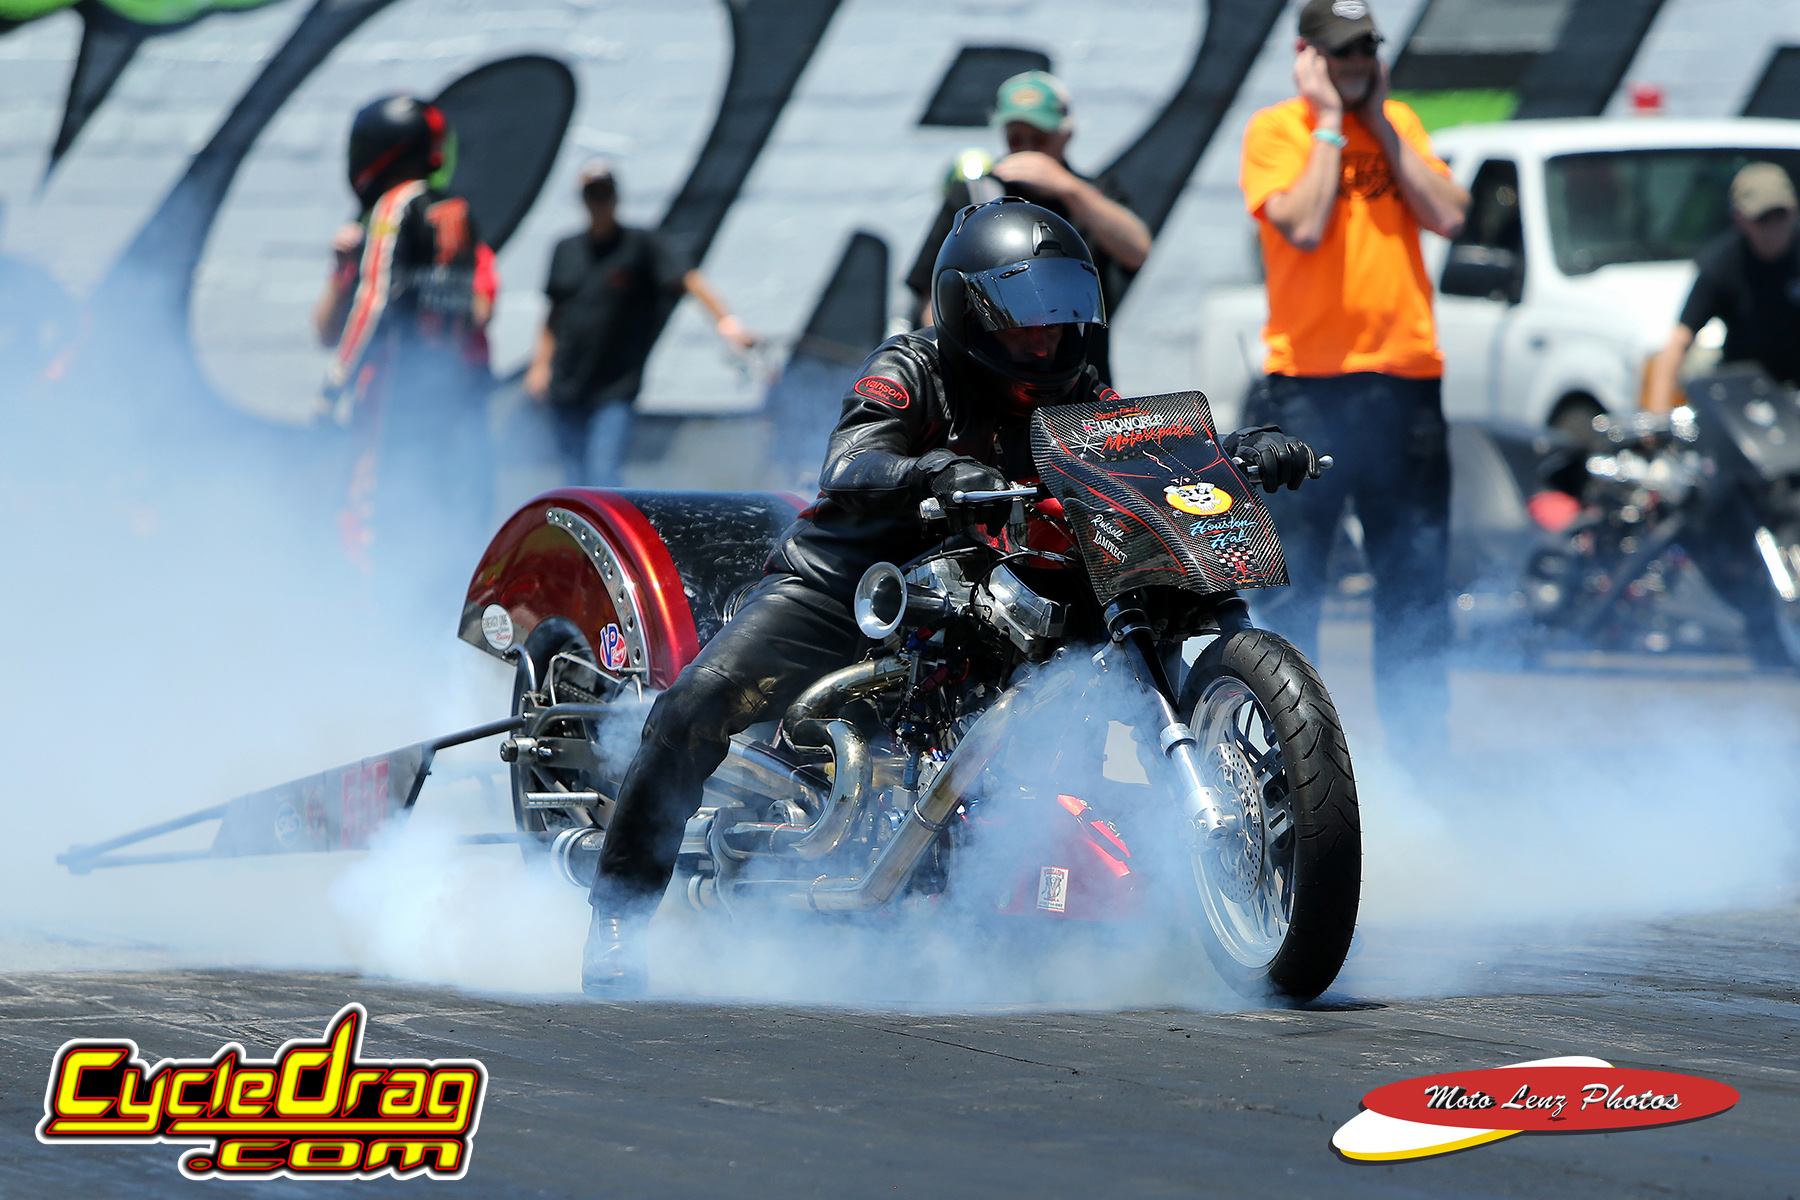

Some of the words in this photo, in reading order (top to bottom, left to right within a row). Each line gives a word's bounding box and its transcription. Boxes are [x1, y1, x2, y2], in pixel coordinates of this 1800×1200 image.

[1091, 514, 1125, 543] Russell
[1190, 516, 1258, 537] Houston
[1210, 529, 1252, 549] Hal
